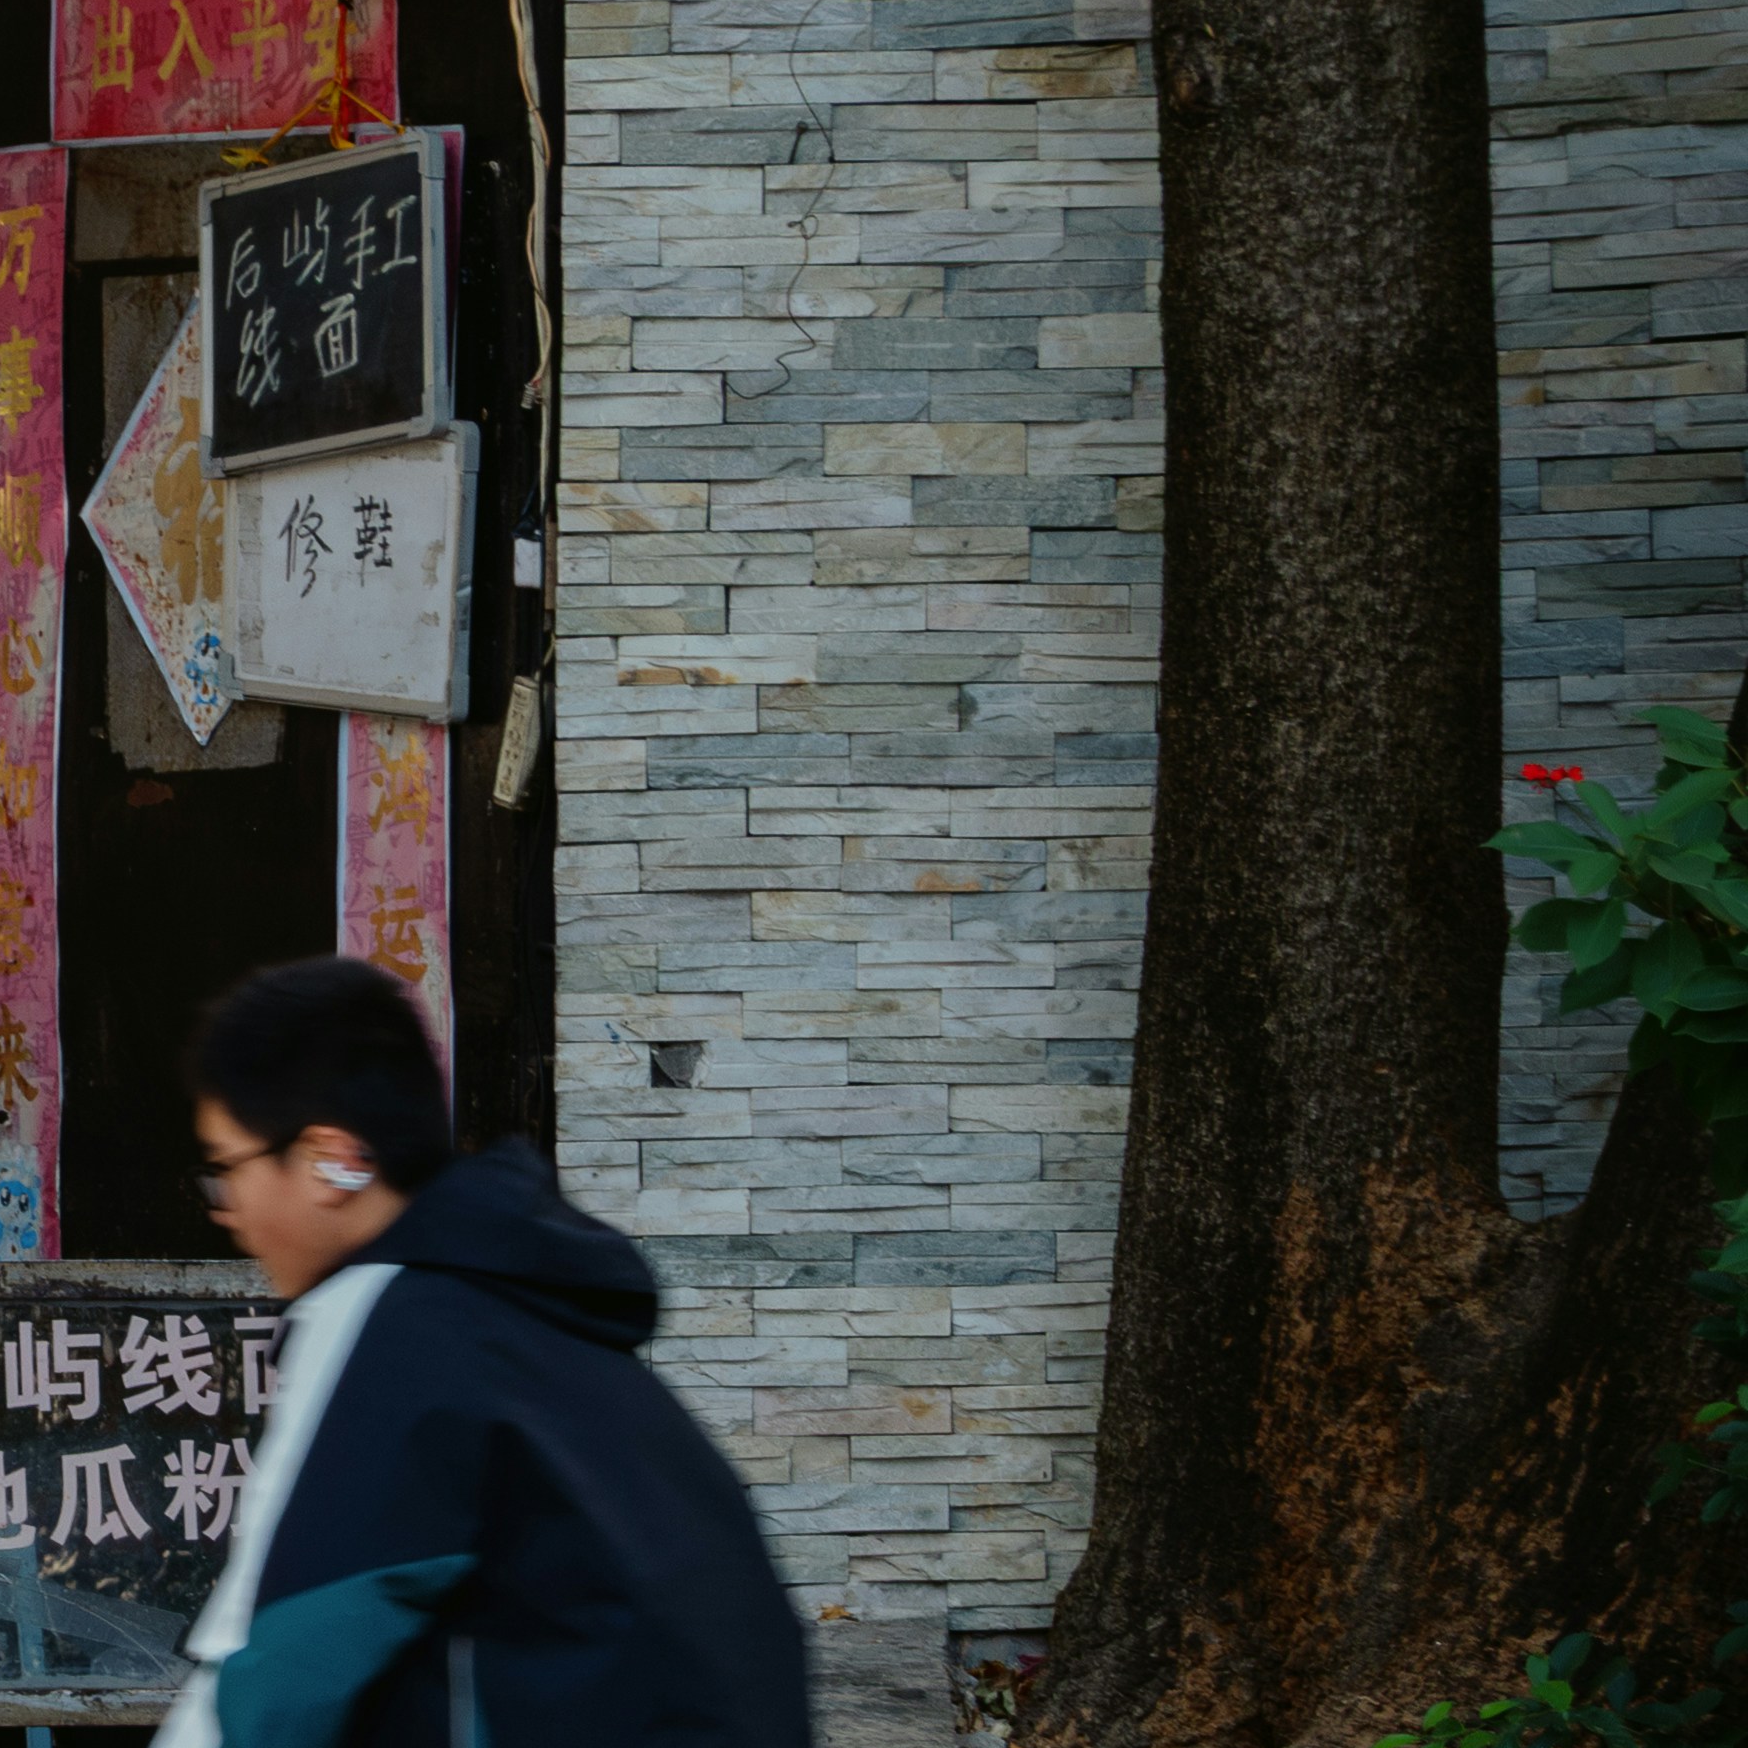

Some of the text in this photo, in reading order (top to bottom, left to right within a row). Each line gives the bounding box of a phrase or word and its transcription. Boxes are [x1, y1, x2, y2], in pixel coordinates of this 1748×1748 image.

[226, 194, 418, 310] 后屿手工
[235, 293, 358, 409] 线面
[278, 493, 395, 598] 修鞋
